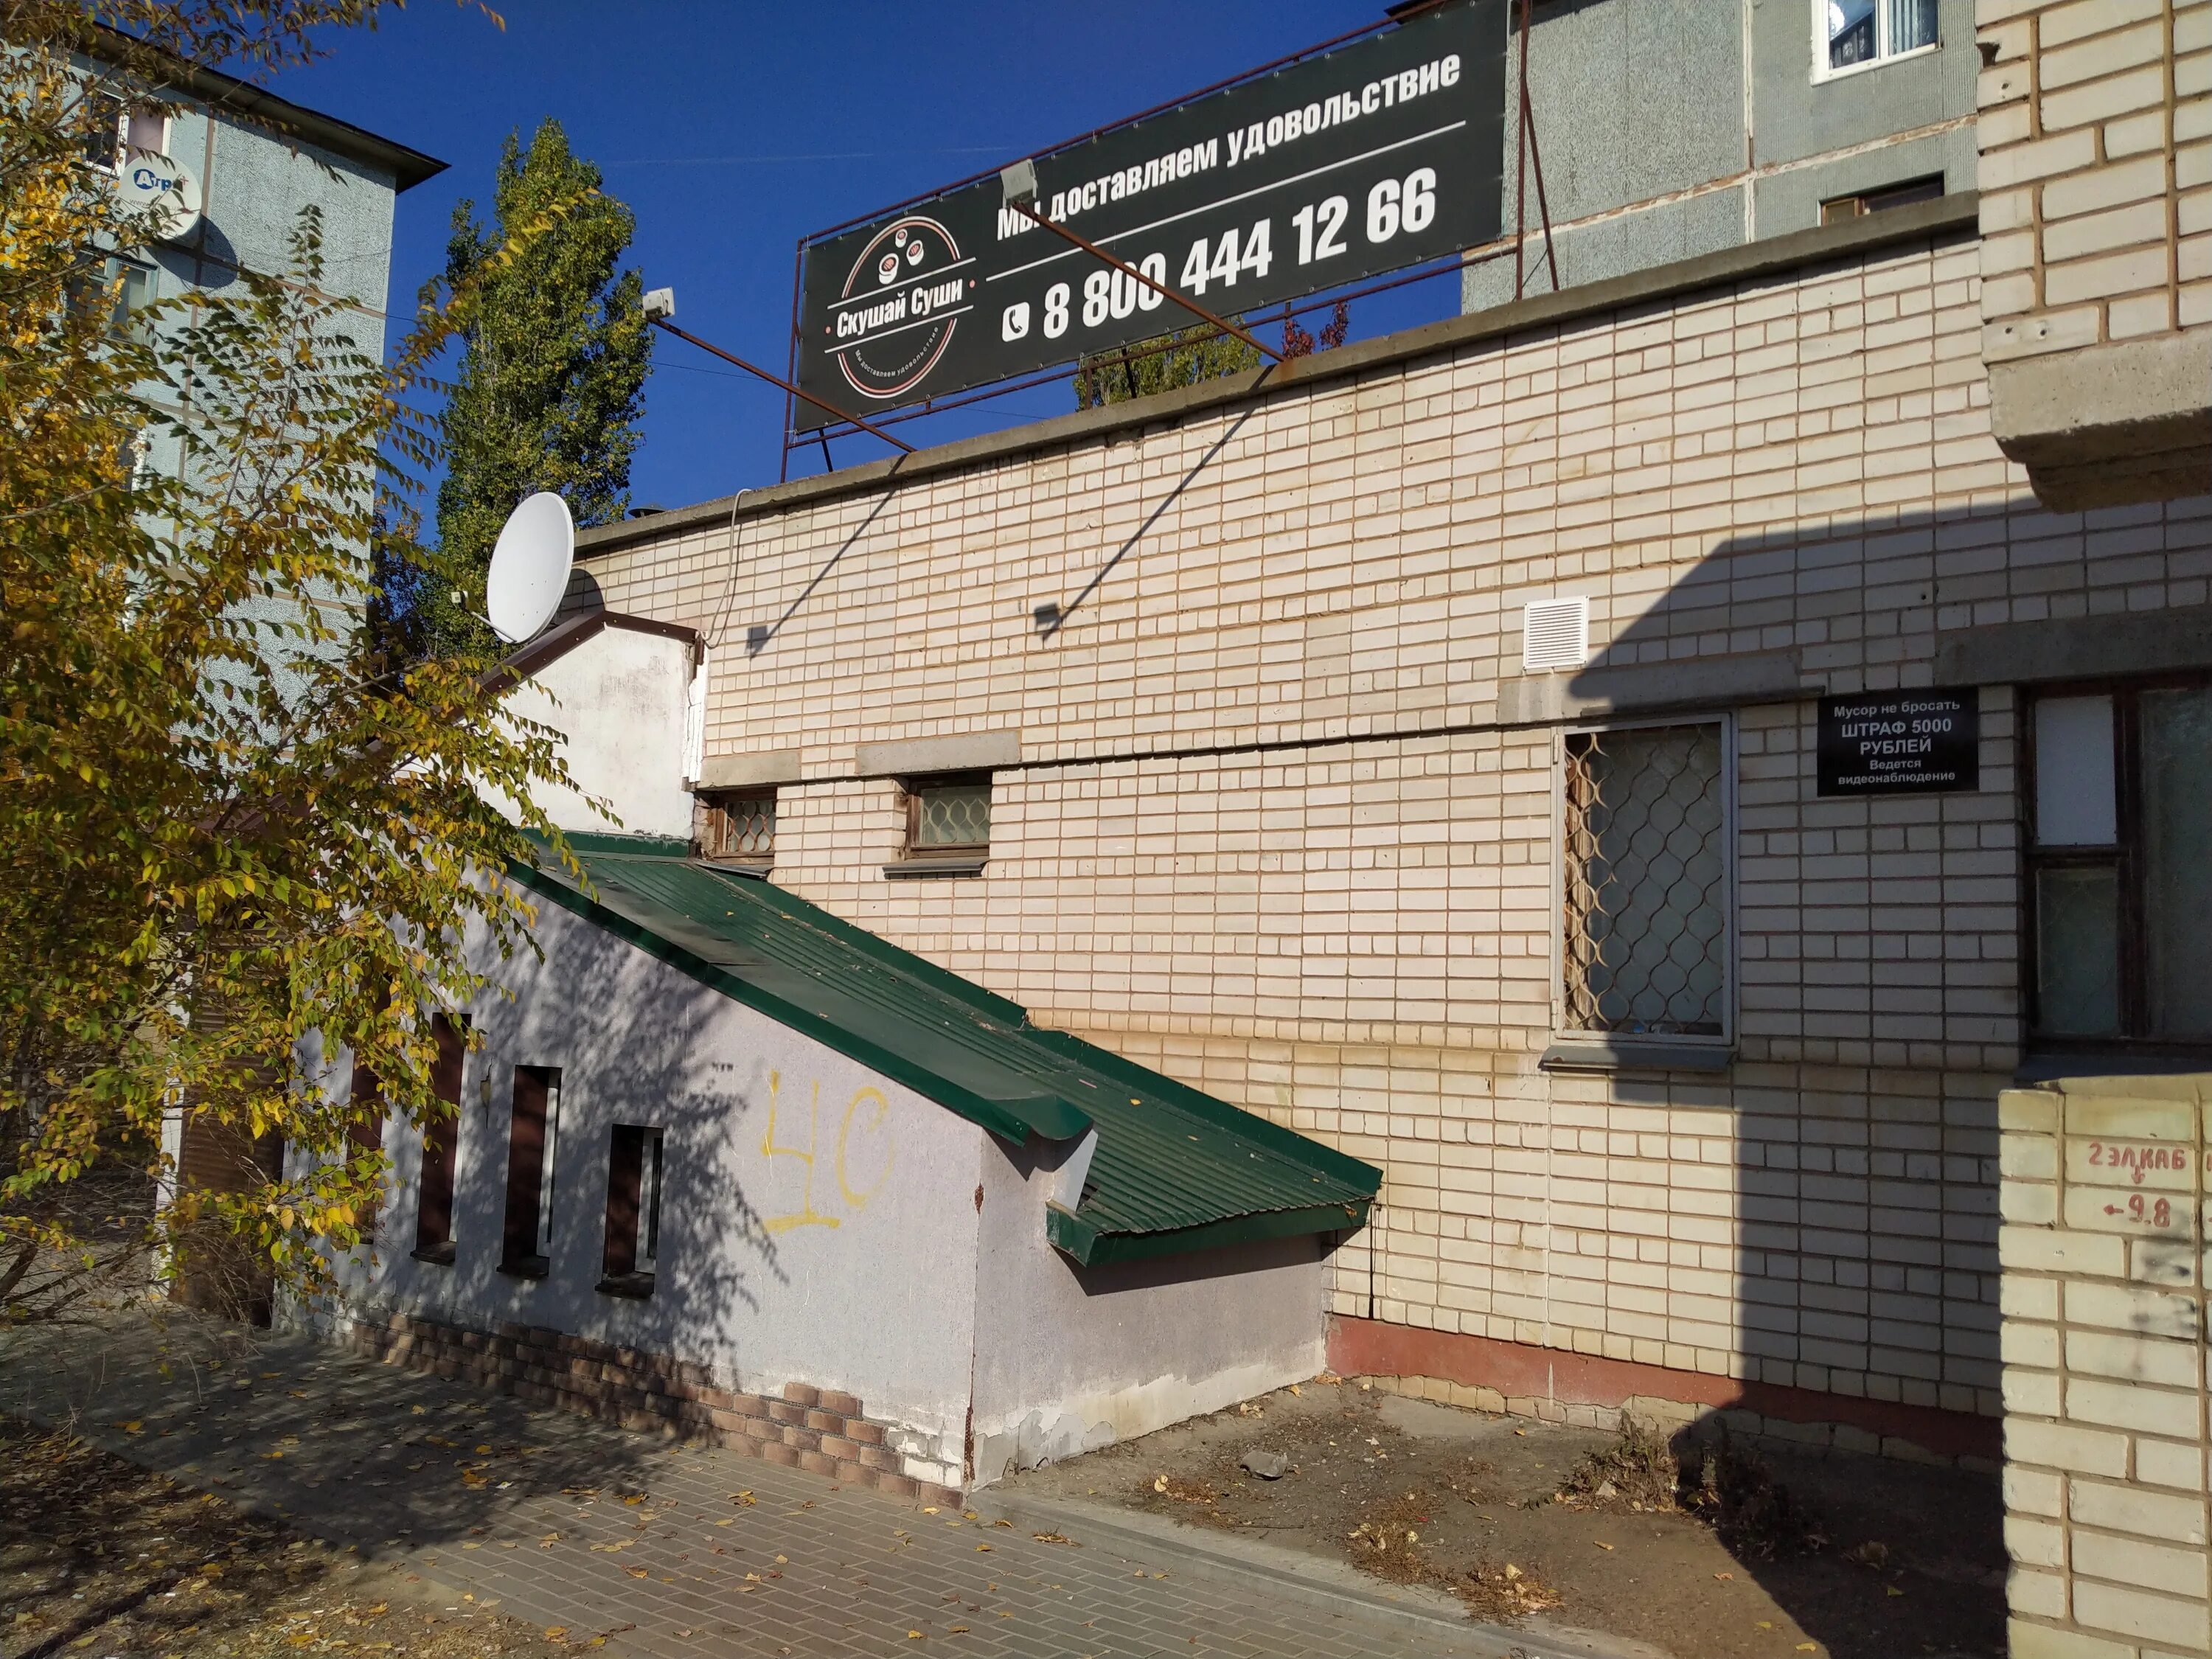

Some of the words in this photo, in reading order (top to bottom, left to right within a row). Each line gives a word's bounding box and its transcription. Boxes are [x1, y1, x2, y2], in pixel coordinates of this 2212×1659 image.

[997, 201, 1040, 240] Мы
[1048, 138, 1217, 223] доставляем
[1227, 54, 1461, 167] удовольствие
[1043, 282, 1070, 339] 8
[1082, 252, 1166, 327] 800
[1180, 218, 1272, 296] 444
[1293, 195, 1349, 265] 12
[1366, 167, 1436, 243] 66
[837, 291, 905, 338] Скушай
[911, 279, 963, 316] Суши
[855, 349, 863, 362] Мы
[860, 361, 897, 378] доставляем
[897, 327, 939, 376] удовольствие
[1834, 706, 1877, 718] Мусор
[1881, 703, 1897, 714] не
[1902, 700, 1961, 714] бросать
[1841, 720, 1906, 738] ШТРАФ
[1911, 718, 1952, 733] 5000
[1860, 734, 1932, 755] РУБЛЕЙ
[1869, 759, 1922, 771] Ведется
[1838, 772, 1956, 785] видеонаблюдение
